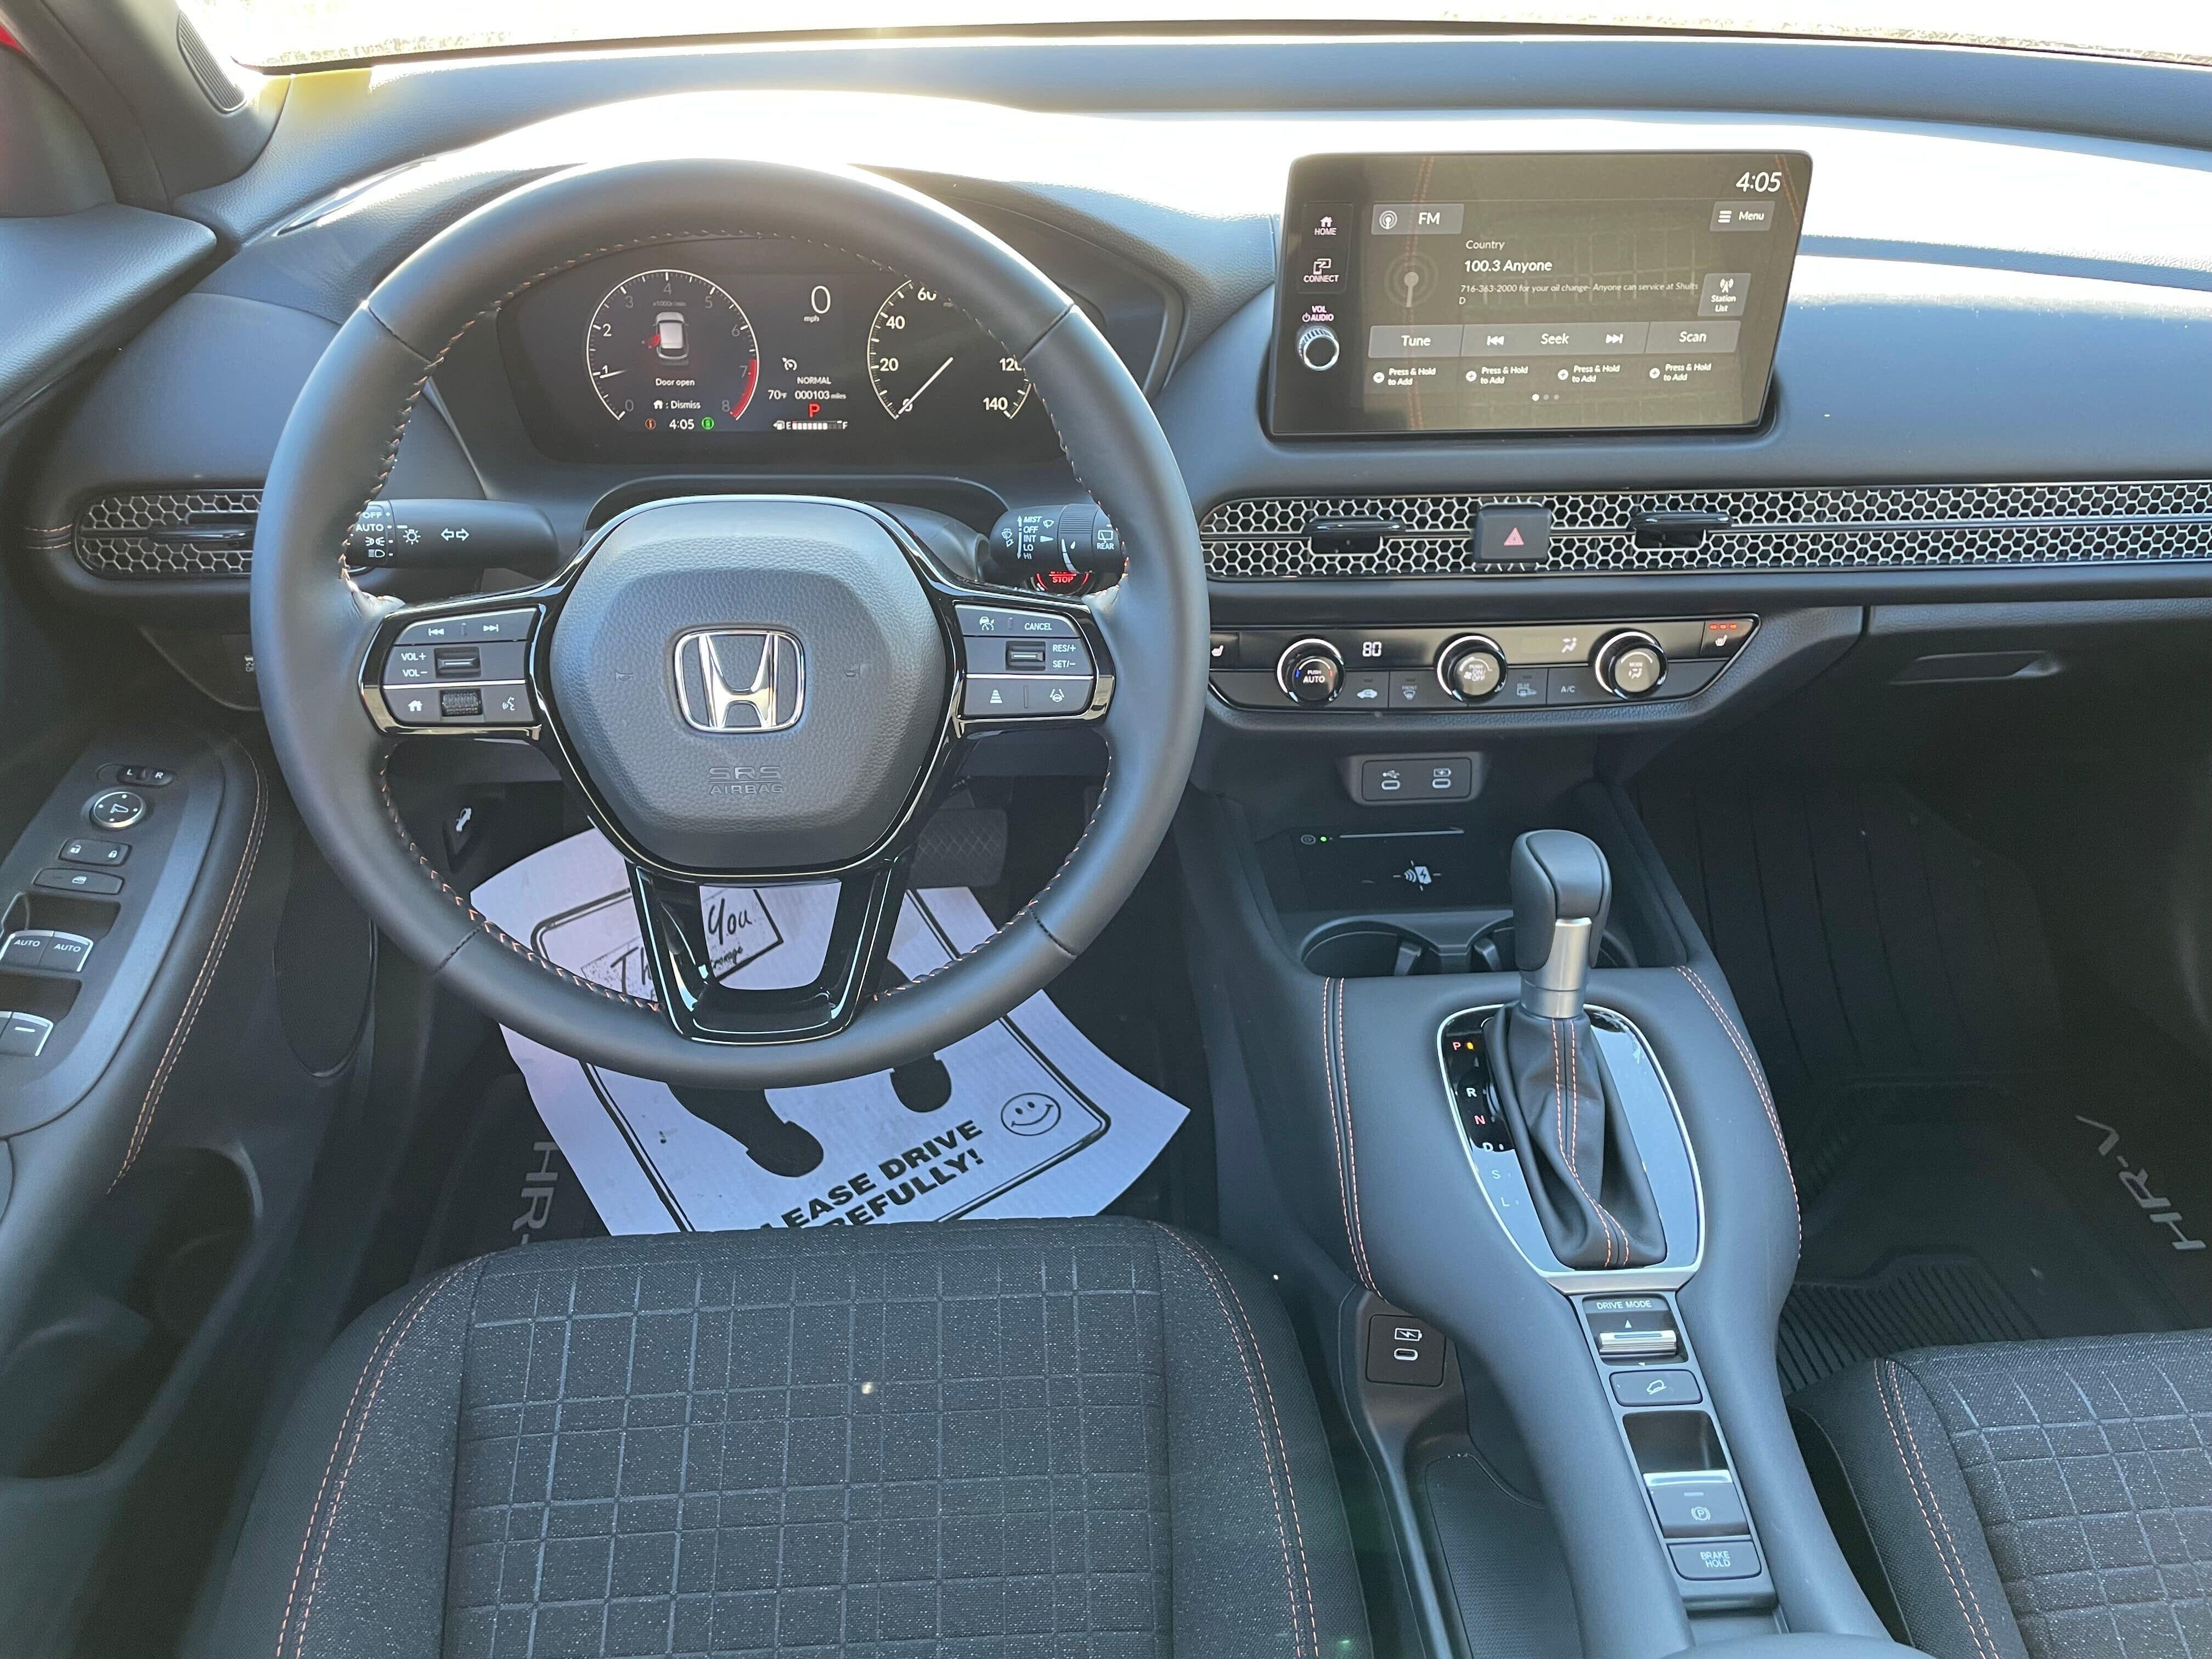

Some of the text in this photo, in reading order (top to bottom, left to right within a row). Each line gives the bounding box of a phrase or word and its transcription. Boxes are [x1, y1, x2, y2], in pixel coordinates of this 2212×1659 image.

[1736, 172, 1782, 192] 4:05
[1418, 212, 1440, 225] FM
[1739, 211, 1764, 221] Menu
[1465, 240, 1505, 251] Country
[1464, 259, 1553, 274] 100.3 Anyone
[1303, 274, 1339, 283] CONNECT
[663, 283, 672, 295] 4
[917, 286, 936, 301] 60
[1460, 284, 1517, 293] 716-363-2000
[1561, 284, 1591, 292] change-
[1592, 283, 1622, 292] Anyone
[1675, 282, 1699, 290] Shults
[625, 296, 634, 308] 3
[705, 296, 713, 308] 5
[811, 285, 831, 314] 0
[1711, 295, 1736, 303] Station
[886, 315, 905, 329] 40
[603, 324, 612, 337] 2
[731, 324, 740, 337] 6
[1401, 335, 1431, 346] Tune
[1541, 333, 1570, 345] Seek
[1679, 331, 1707, 343] Scan
[602, 364, 608, 374] 1
[879, 358, 899, 371] 20
[1481, 366, 1502, 375] Press
[1510, 366, 1528, 374] Hold
[1573, 365, 1593, 373] Press
[1594, 365, 1601, 373] &
[740, 365, 748, 378] 7
[1389, 368, 1409, 376] Press
[797, 376, 832, 385] NORMAL
[794, 390, 830, 399] 000103
[625, 399, 634, 411] 0
[671, 400, 701, 409] Dismiss
[722, 400, 730, 412] 8
[809, 403, 821, 417] P
[983, 397, 1008, 411] 140
[669, 419, 695, 430] 4:05
[786, 421, 848, 430] E F
[1052, 644, 1076, 652] RES/+
[1362, 641, 1382, 657] 80
[401, 652, 426, 661] VOL+
[709, 766, 781, 780] SRS
[710, 784, 784, 794] AIRBAG
[708, 898, 752, 945] You
[14, 938, 81, 952] AUTO AUTO
[611, 946, 651, 994] Th
[1453, 1041, 1461, 1051] P
[1466, 1087, 1477, 1098] R
[1475, 1115, 1486, 1125] N
[1482, 1142, 1494, 1152] D
[761, 1120, 983, 1228] EASE DRIVE
[1492, 1170, 1500, 1179] S
[822, 1148, 984, 1228] EFULLY!
[2075, 1115, 2206, 1250] HR-V
[512, 1142, 559, 1244] HR-
[1501, 1197, 1510, 1206] L
[1596, 1300, 1652, 1310] DRIVE MODE
[1701, 1551, 1730, 1560] BRAKE
[1706, 1559, 1731, 1568] HOLD
